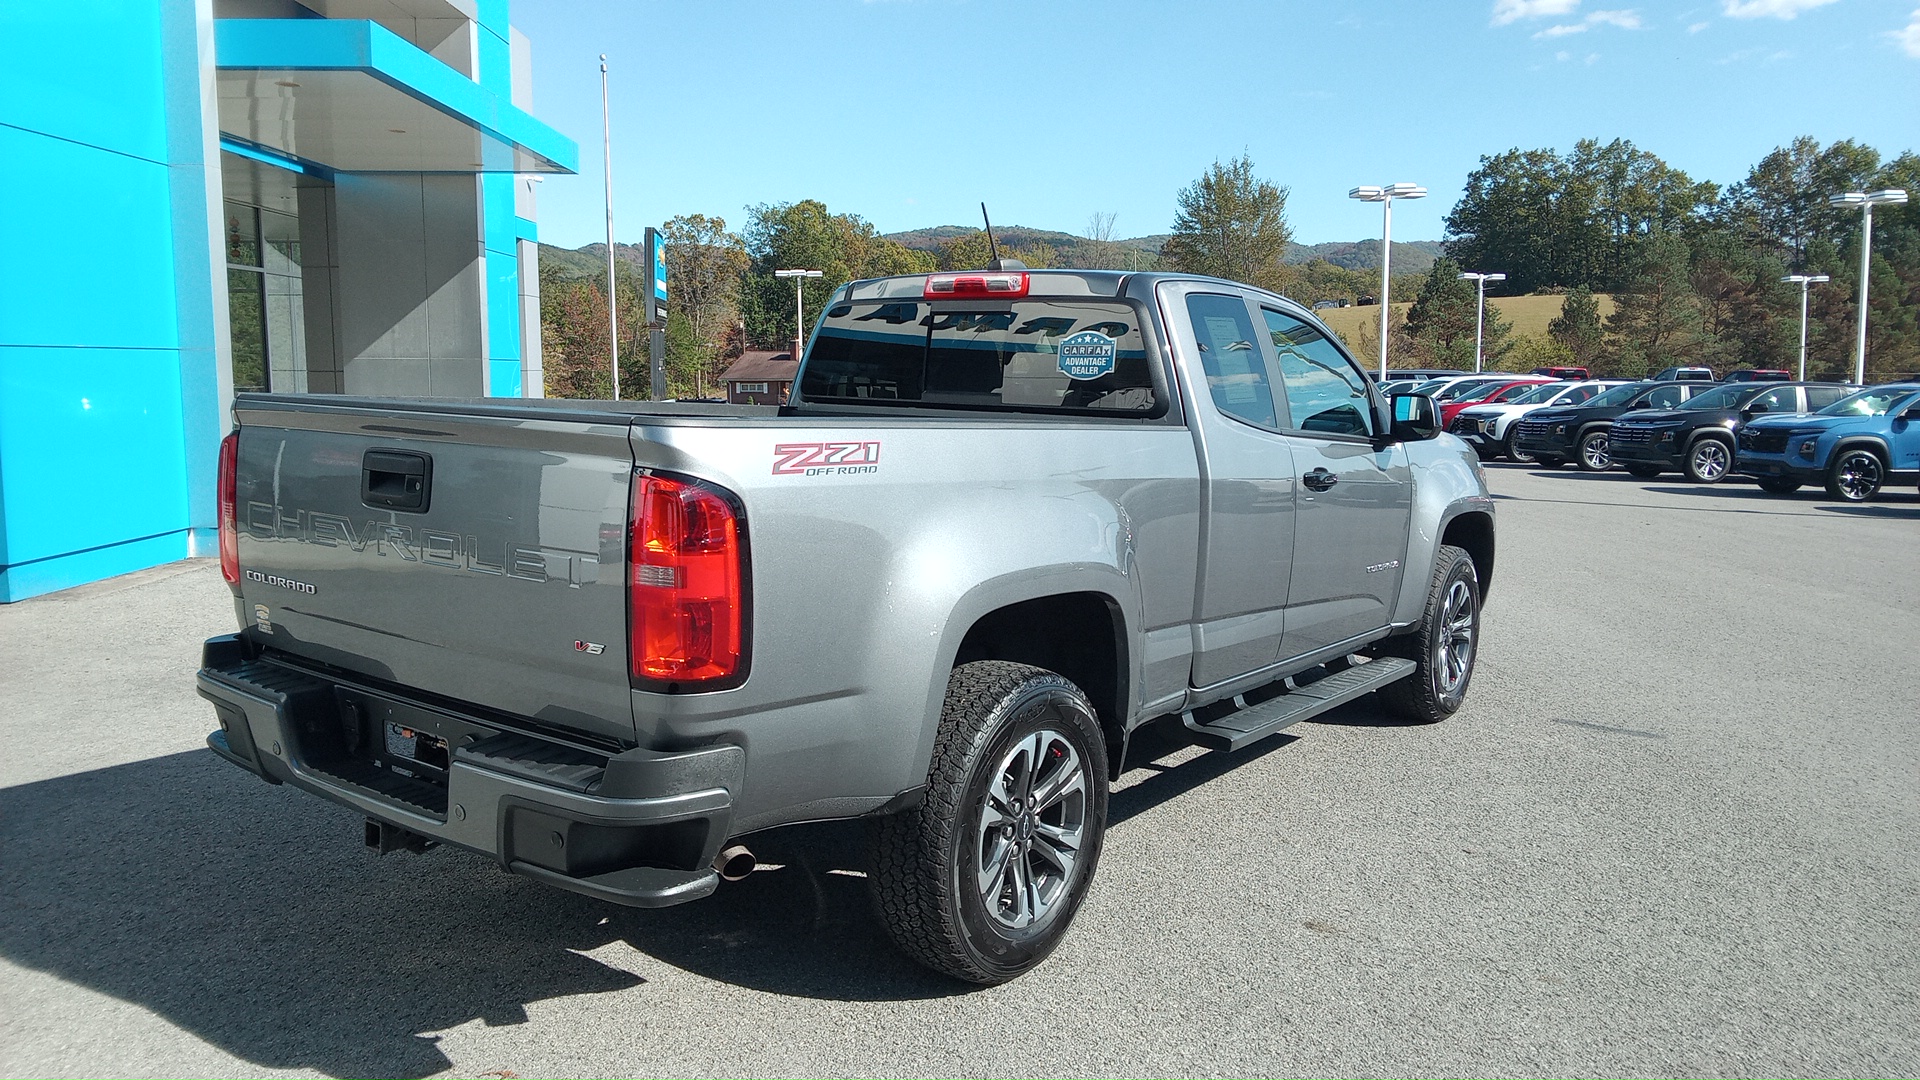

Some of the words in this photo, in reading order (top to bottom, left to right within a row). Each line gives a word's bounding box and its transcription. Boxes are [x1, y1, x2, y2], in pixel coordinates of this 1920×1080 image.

[1064, 346, 1110, 355] CARFAX
[1071, 366, 1099, 375] DEALER
[772, 441, 880, 475] Z71
[806, 468, 834, 476] OFF
[838, 466, 877, 475] ROAD
[247, 500, 600, 589] CHEVROLET
[246, 570, 317, 595] COLORADO
[574, 639, 606, 656] V6
